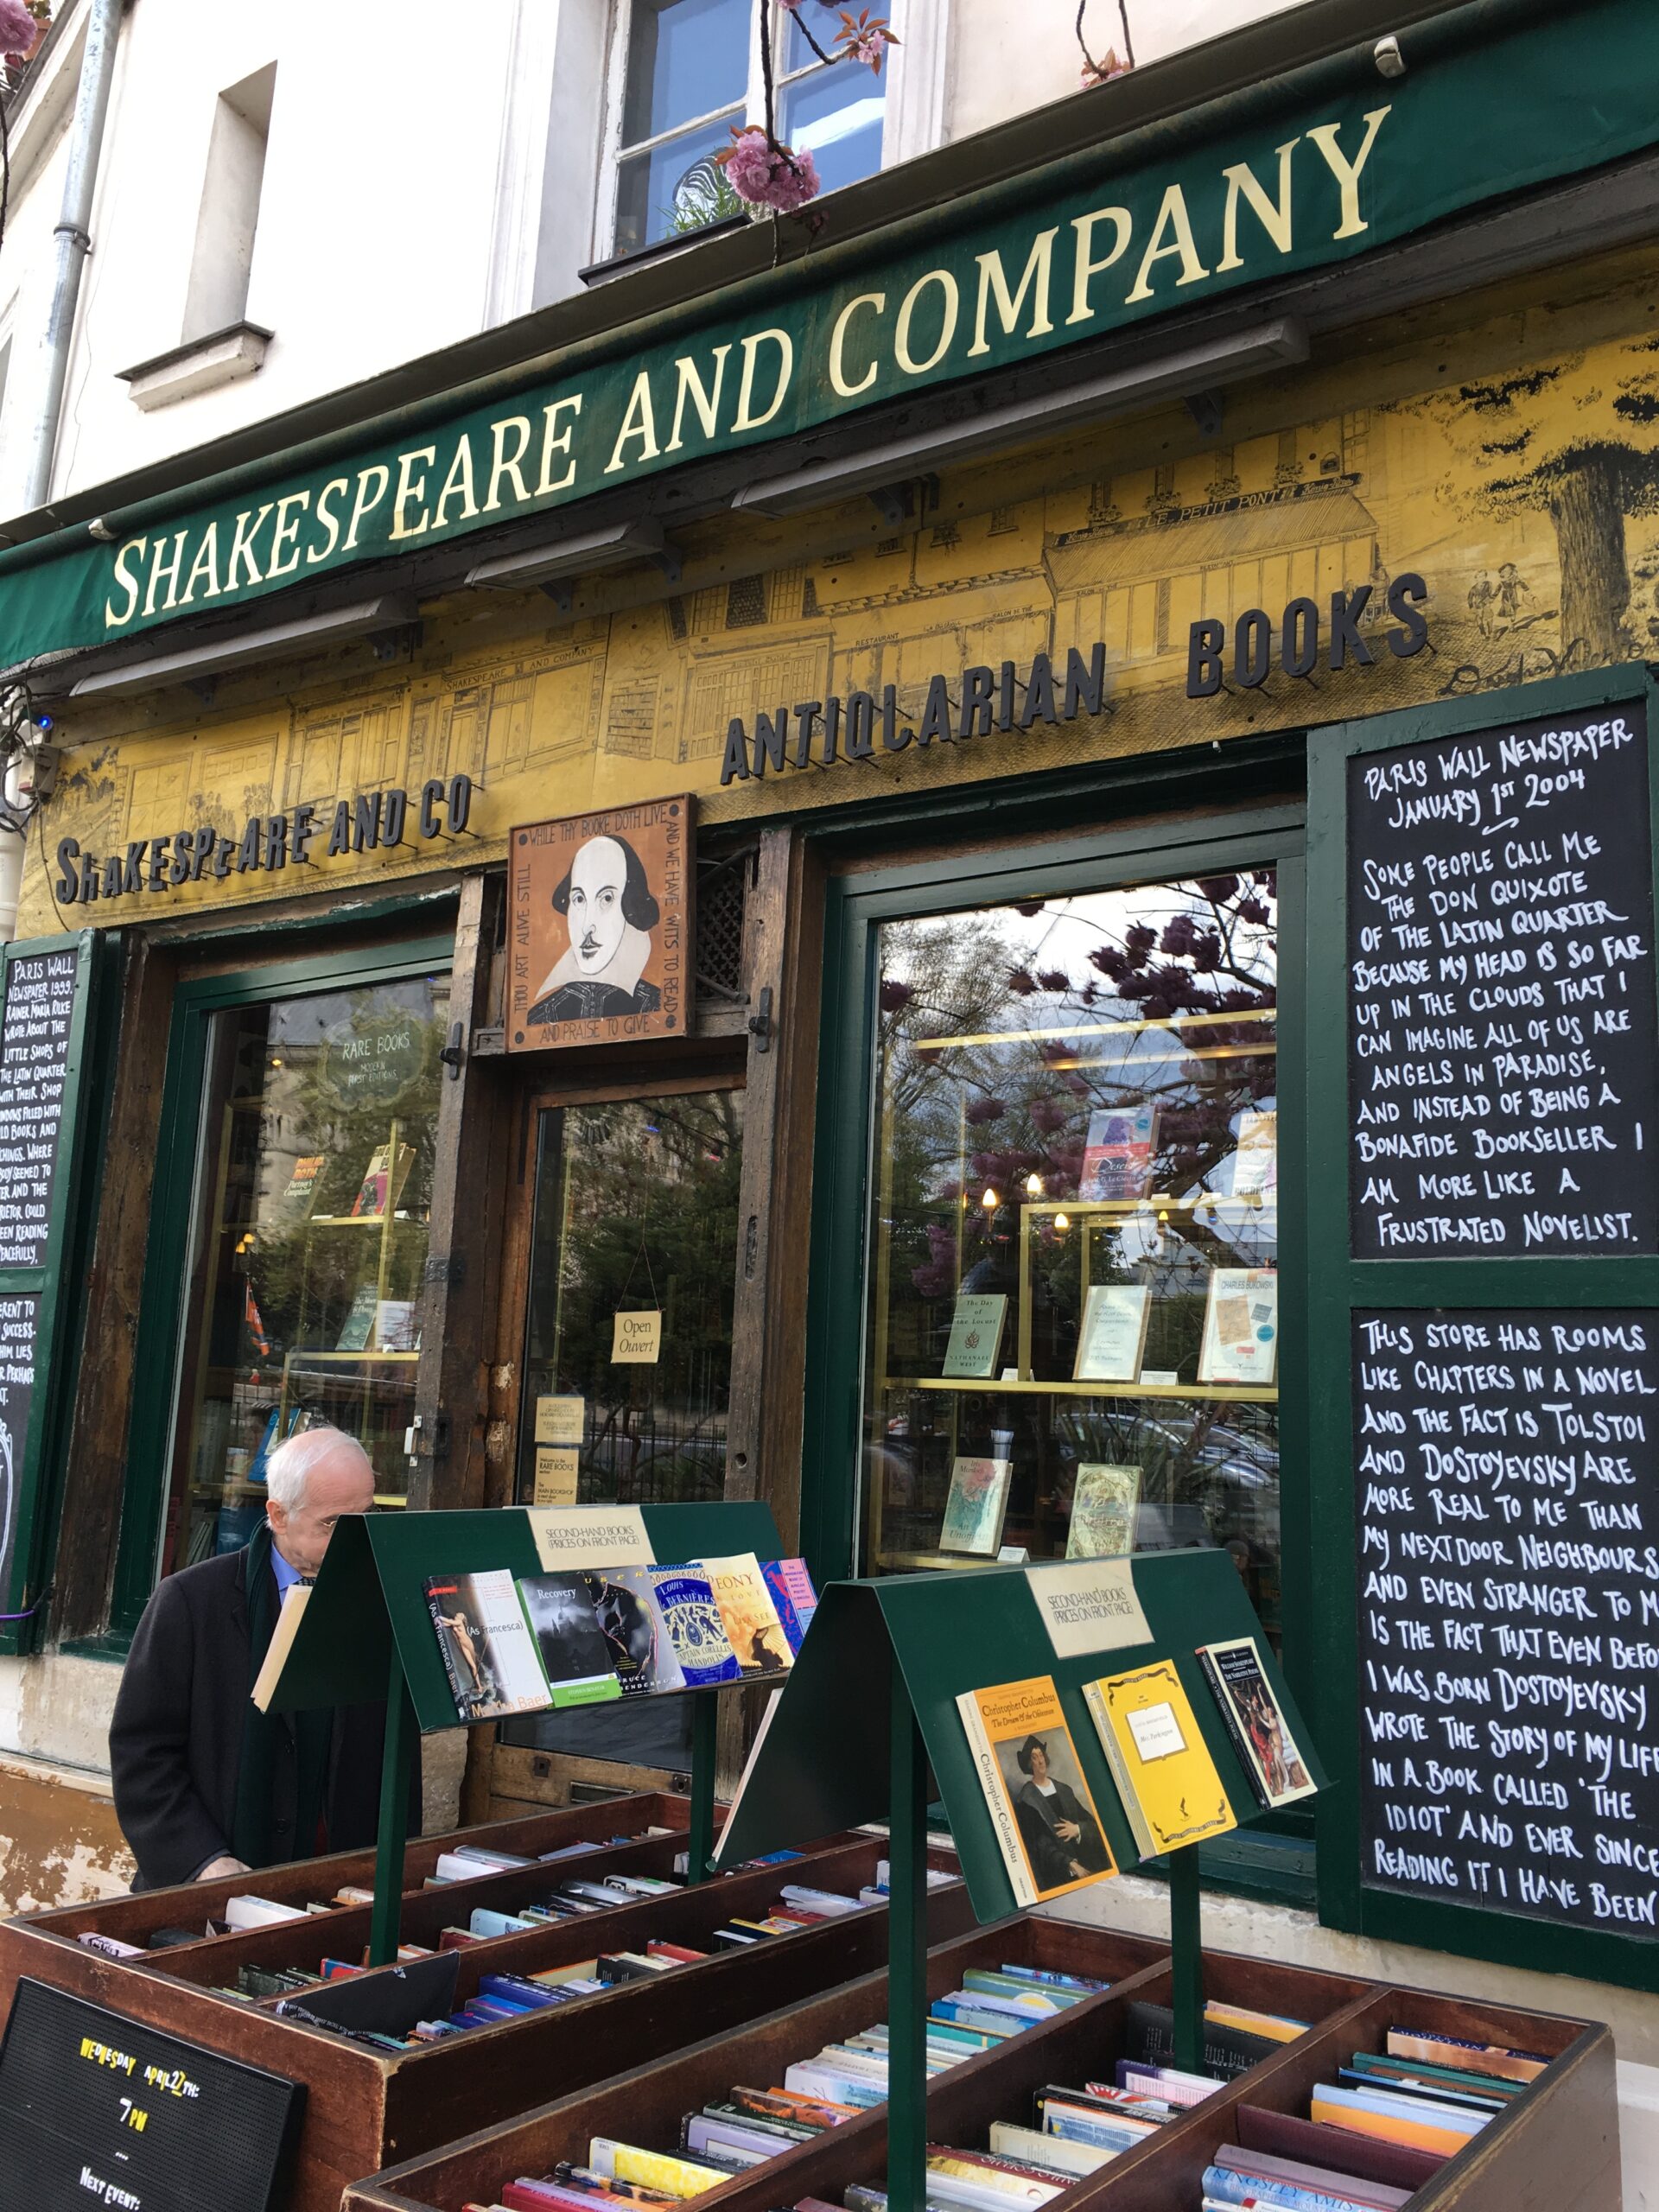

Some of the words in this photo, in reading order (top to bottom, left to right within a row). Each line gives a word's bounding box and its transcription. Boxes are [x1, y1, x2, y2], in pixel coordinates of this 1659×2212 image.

[104, 393, 583, 629] SHAKESPEARE
[603, 327, 795, 474] AND
[829, 105, 1392, 397] COMPANY
[1179, 499, 1232, 520] PETIT
[1236, 490, 1280, 509] PONT
[855, 632, 899, 646] RESTAURANT
[1186, 572, 1428, 699] BOOKS
[445, 668, 506, 691] SHAKESPEARE
[531, 658, 549, 670] AND
[553, 646, 594, 664] COMPANY
[1364, 760, 1427, 801] PARIS
[1439, 746, 1491, 781] WALL
[1499, 718, 1633, 773] NEWSPAPER
[1389, 789, 1480, 829] JANUARY
[1491, 781, 1515, 816] 1ST
[1524, 768, 1585, 808] 2004
[327, 788, 407, 858] AND
[420, 773, 472, 839] CO
[529, 829, 555, 847] WHILE
[561, 823, 578, 842] THY
[582, 815, 610, 836] BOOKE
[615, 810, 642, 831] DOTH
[645, 804, 668, 827] LIVE
[666, 821, 680, 844] AND
[665, 848, 680, 868] WE
[1363, 859, 1415, 900] SOME
[1423, 849, 1494, 885] PEOPLE
[1505, 839, 1552, 869] CALL
[1562, 831, 1601, 862] ME
[518, 864, 531, 901] STILL
[664, 870, 680, 906] HAVE
[1382, 894, 1415, 921] THE
[1429, 883, 1478, 916] DON
[1491, 870, 1588, 905] QUIXOTE
[517, 908, 529, 945] ALIVE
[664, 915, 679, 950] WITS
[1361, 926, 1382, 951] OF
[1391, 923, 1432, 950] THE
[1440, 918, 1504, 947] LATIN
[1512, 900, 1629, 935] QUARTER
[14, 959, 42, 983] PARIS
[48, 956, 74, 977] WALL
[516, 954, 528, 978] ART
[664, 954, 679, 971] TO
[1352, 959, 1431, 992] BECAUSE
[1440, 955, 1467, 985] MY
[1475, 950, 1527, 979] HEAD
[1537, 941, 1557, 972] IS
[1567, 940, 1594, 969] SO
[1602, 934, 1648, 968] FAR
[8, 982, 49, 1003] NEWSPAPER
[50, 980, 73, 995] 1999.
[514, 982, 527, 1014] THOU
[664, 976, 679, 1013] READ
[1356, 1003, 1380, 1029] UP
[1391, 995, 1411, 1020] IN
[1419, 992, 1456, 1016] THE
[1469, 982, 1544, 1012] CLOUDS
[1554, 974, 1605, 1005] THAT
[1619, 970, 1627, 992] I
[5, 1004, 30, 1023] RAINER
[31, 1002, 50, 1019] MARIA
[52, 1000, 71, 1015] RILKE
[4, 1024, 25, 1042] WROTE
[26, 1020, 49, 1037] ABOUT
[51, 1020, 67, 1035] THE
[539, 1027, 561, 1044] AND
[563, 1019, 600, 1040] PRAISE
[607, 1019, 620, 1035] TO
[624, 1015, 650, 1034] GIVE
[1357, 1030, 1392, 1058] CAN
[1407, 1026, 1478, 1052] IMAGINE
[1484, 1022, 1522, 1049] ALL
[1528, 1019, 1551, 1047] OF
[1557, 1015, 1584, 1045] US
[1593, 1009, 1631, 1035] ARE
[3, 1047, 29, 1064] LITTLE
[30, 1043, 54, 1061] SHOPS
[57, 1040, 68, 1053] OF
[342, 1039, 372, 1060] RARE
[377, 1032, 410, 1054] BOOKS
[0, 1068, 12, 1084] THE
[13, 1066, 32, 1084] LATIN
[34, 1063, 67, 1081] QUARTER
[1371, 1059, 1454, 1091] ANGELS
[1465, 1063, 1484, 1086] IN
[1492, 1049, 1605, 1088] PARADISE,
[1357, 1099, 1401, 1125] AND
[1413, 1095, 1491, 1123] INSTEAD
[1500, 1090, 1522, 1116] OF
[1529, 1085, 1590, 1118] BEING
[1598, 1082, 1622, 1106] A
[1355, 1131, 1459, 1162] BONAFIDE
[1472, 1125, 1618, 1160] BOOKSELLER
[1635, 1122, 1643, 1150] I
[1377, 1212, 1506, 1247] FRUSTRATED
[1522, 1211, 1638, 1247] NOVELIST.
[1221, 1281, 1245, 1290] CHARLES
[1245, 1281, 1274, 1290] BUKOWSKI
[624, 1319, 652, 1337] Open
[1359, 1319, 1414, 1356] THIS
[1426, 1323, 1491, 1352] STORE
[1497, 1324, 1542, 1352] HAS
[1552, 1325, 1647, 1355] ROOMS
[620, 1339, 653, 1353] Ouvert
[554, 1463, 574, 1471] BOOKS
[546, 1527, 606, 1538] SECOND-HAND
[607, 1525, 634, 1535] BOOKS
[549, 1538, 575, 1549] (PRICES
[577, 1537, 592, 1548] ON
[592, 1536, 617, 1547] FRONT
[619, 1535, 639, 1545] PAGE)
[537, 1589, 575, 1599] Recovery
[659, 1581, 684, 1596] LOUIS
[707, 1573, 753, 1590] PEONY
[1047, 1587, 1102, 1610] SECOND-HAND
[1102, 1587, 1126, 1602] BOOKS
[1053, 1608, 1079, 1625] (PRICES
[1078, 1607, 1092, 1620] ON
[1091, 1604, 1115, 1618] FRONT
[1115, 1601, 1134, 1616] PAGE)
[467, 1626, 480, 1637] (As
[481, 1620, 524, 1634] Francesca)
[429, 1603, 437, 1618] (As
[435, 1622, 453, 1670] Francesca)
[448, 1672, 458, 1694] Baer
[518, 1694, 547, 1710] Baer
[982, 1702, 1021, 1716] Christopher
[1020, 1692, 1055, 1707] Columbus
[980, 1752, 1001, 1812] Christopher
[999, 1812, 1017, 1863] Columbus
[79, 2037, 137, 2076] WEDNESDAY
[143, 2065, 172, 2091] APRIL
[119, 2097, 132, 2122] 7
[129, 2108, 149, 2133] PM
[79, 2166, 106, 2195] NEXT
[1213, 2167, 1299, 2197] KINGSLEY
[1307, 2193, 1354, 2212] AMIS
